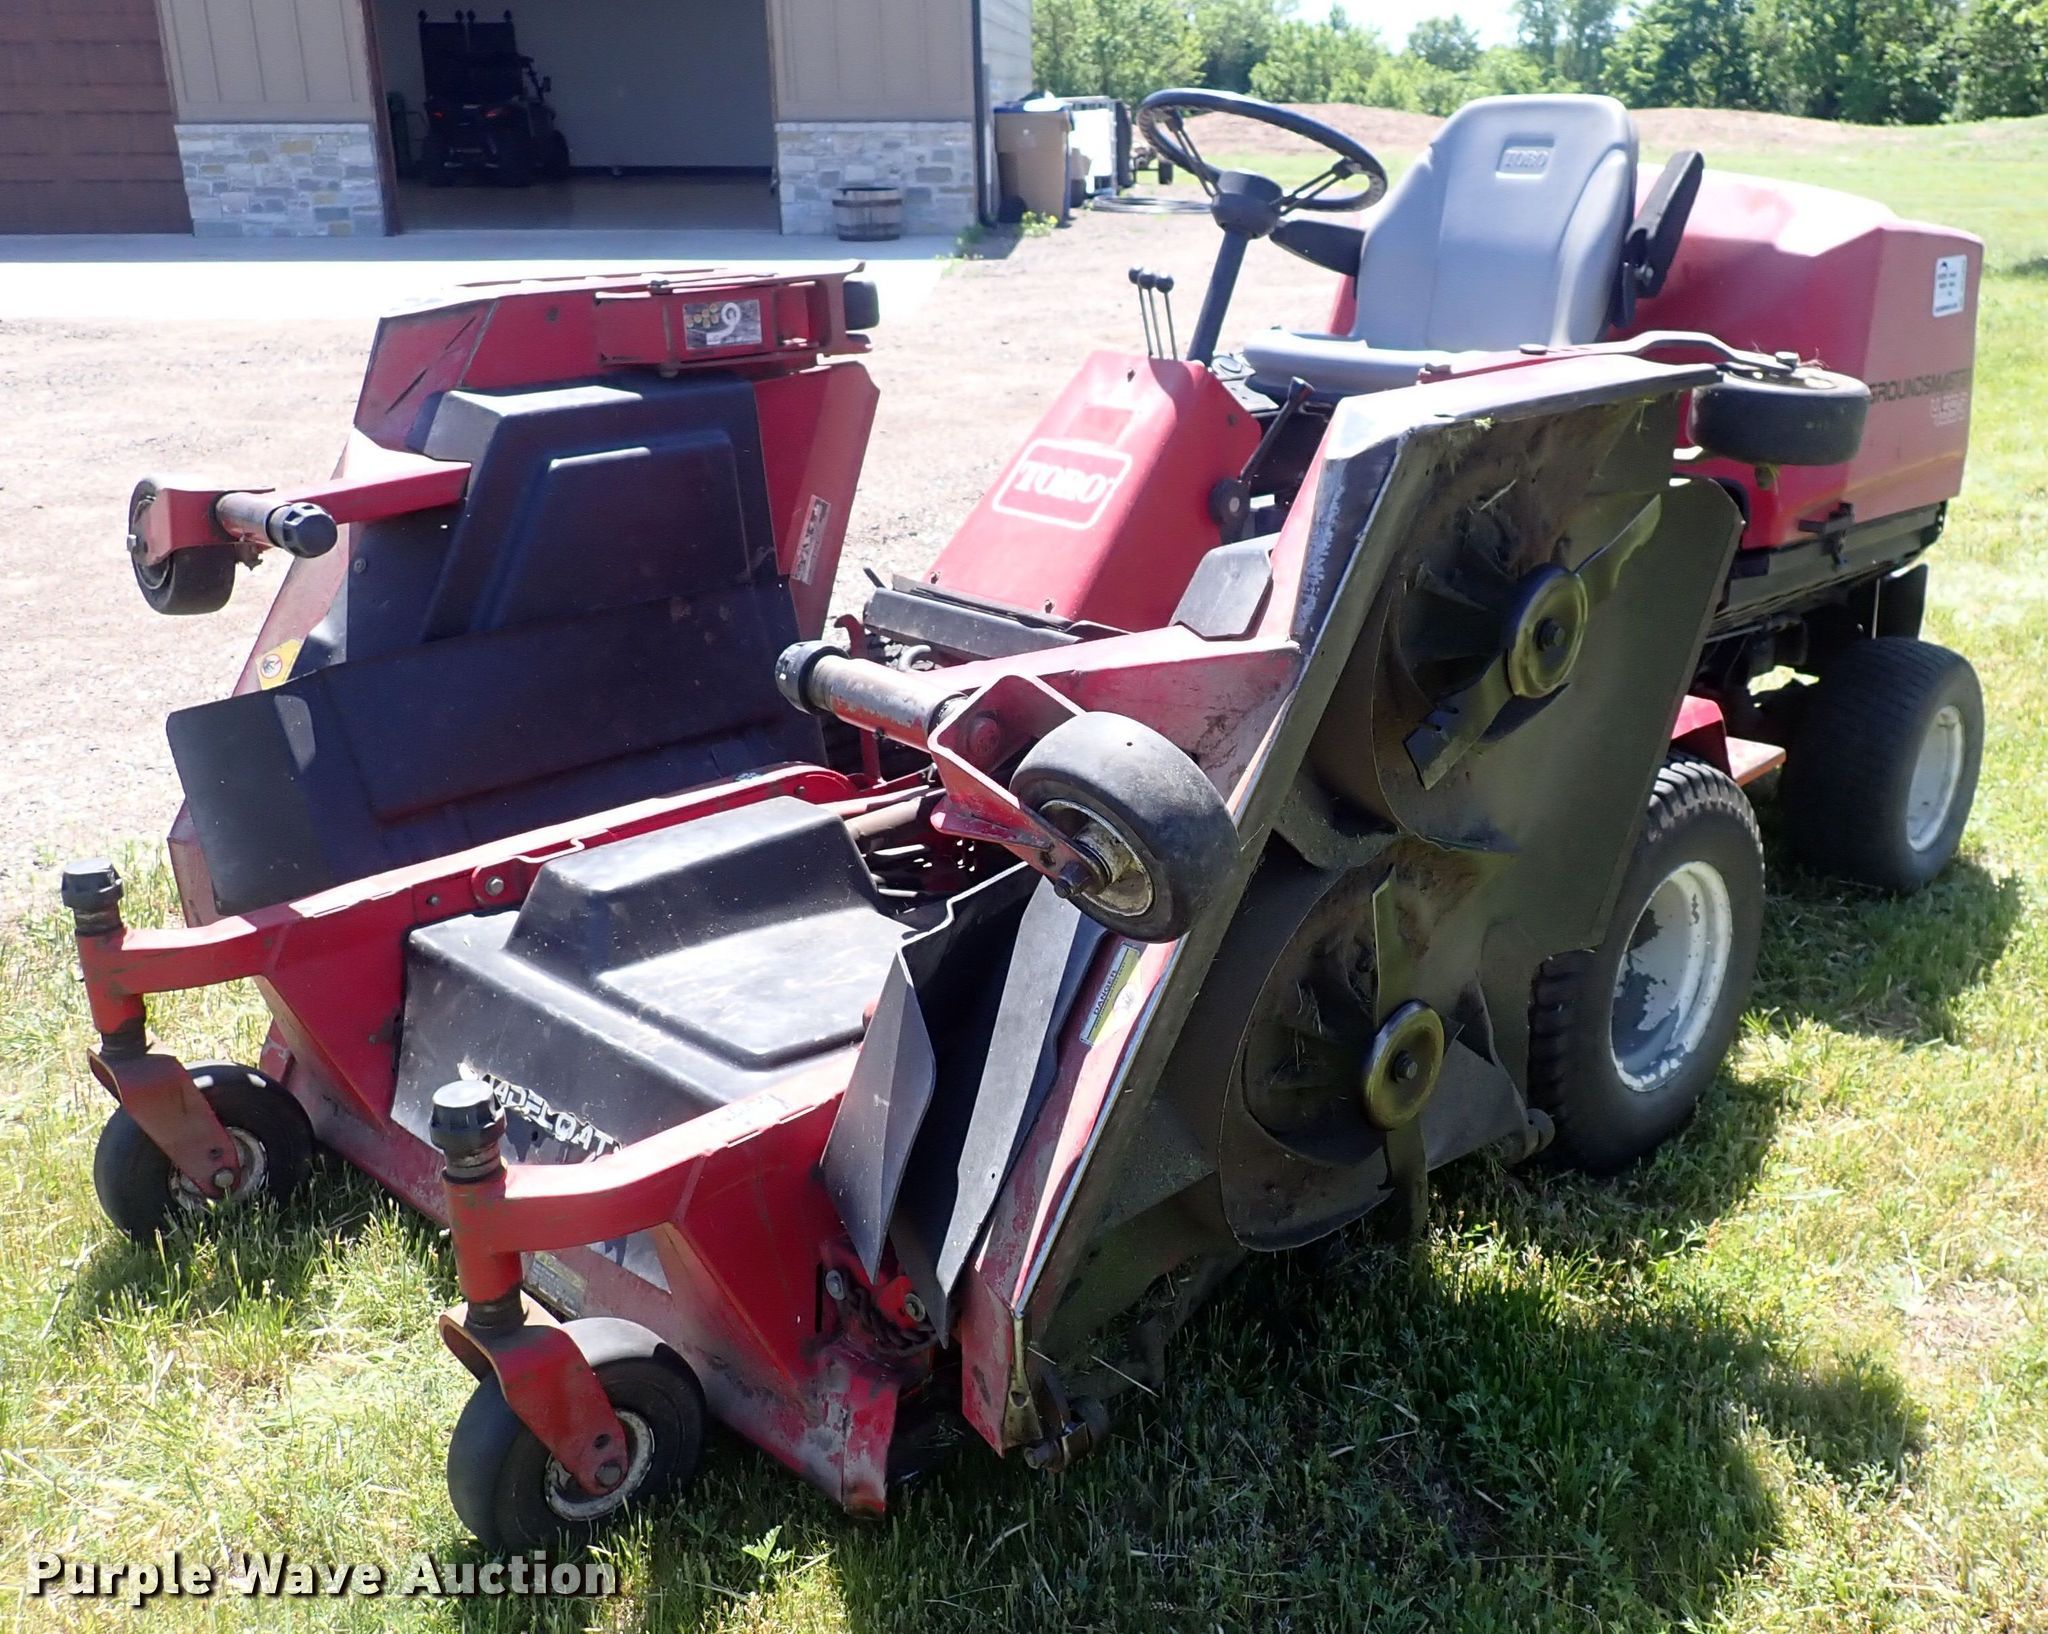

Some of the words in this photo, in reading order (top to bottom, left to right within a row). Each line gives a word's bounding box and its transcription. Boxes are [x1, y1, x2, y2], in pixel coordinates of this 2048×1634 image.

[1503, 149, 1549, 168] TORO
[1014, 460, 1108, 504] TORO
[1093, 970, 1117, 1017] DANGER
